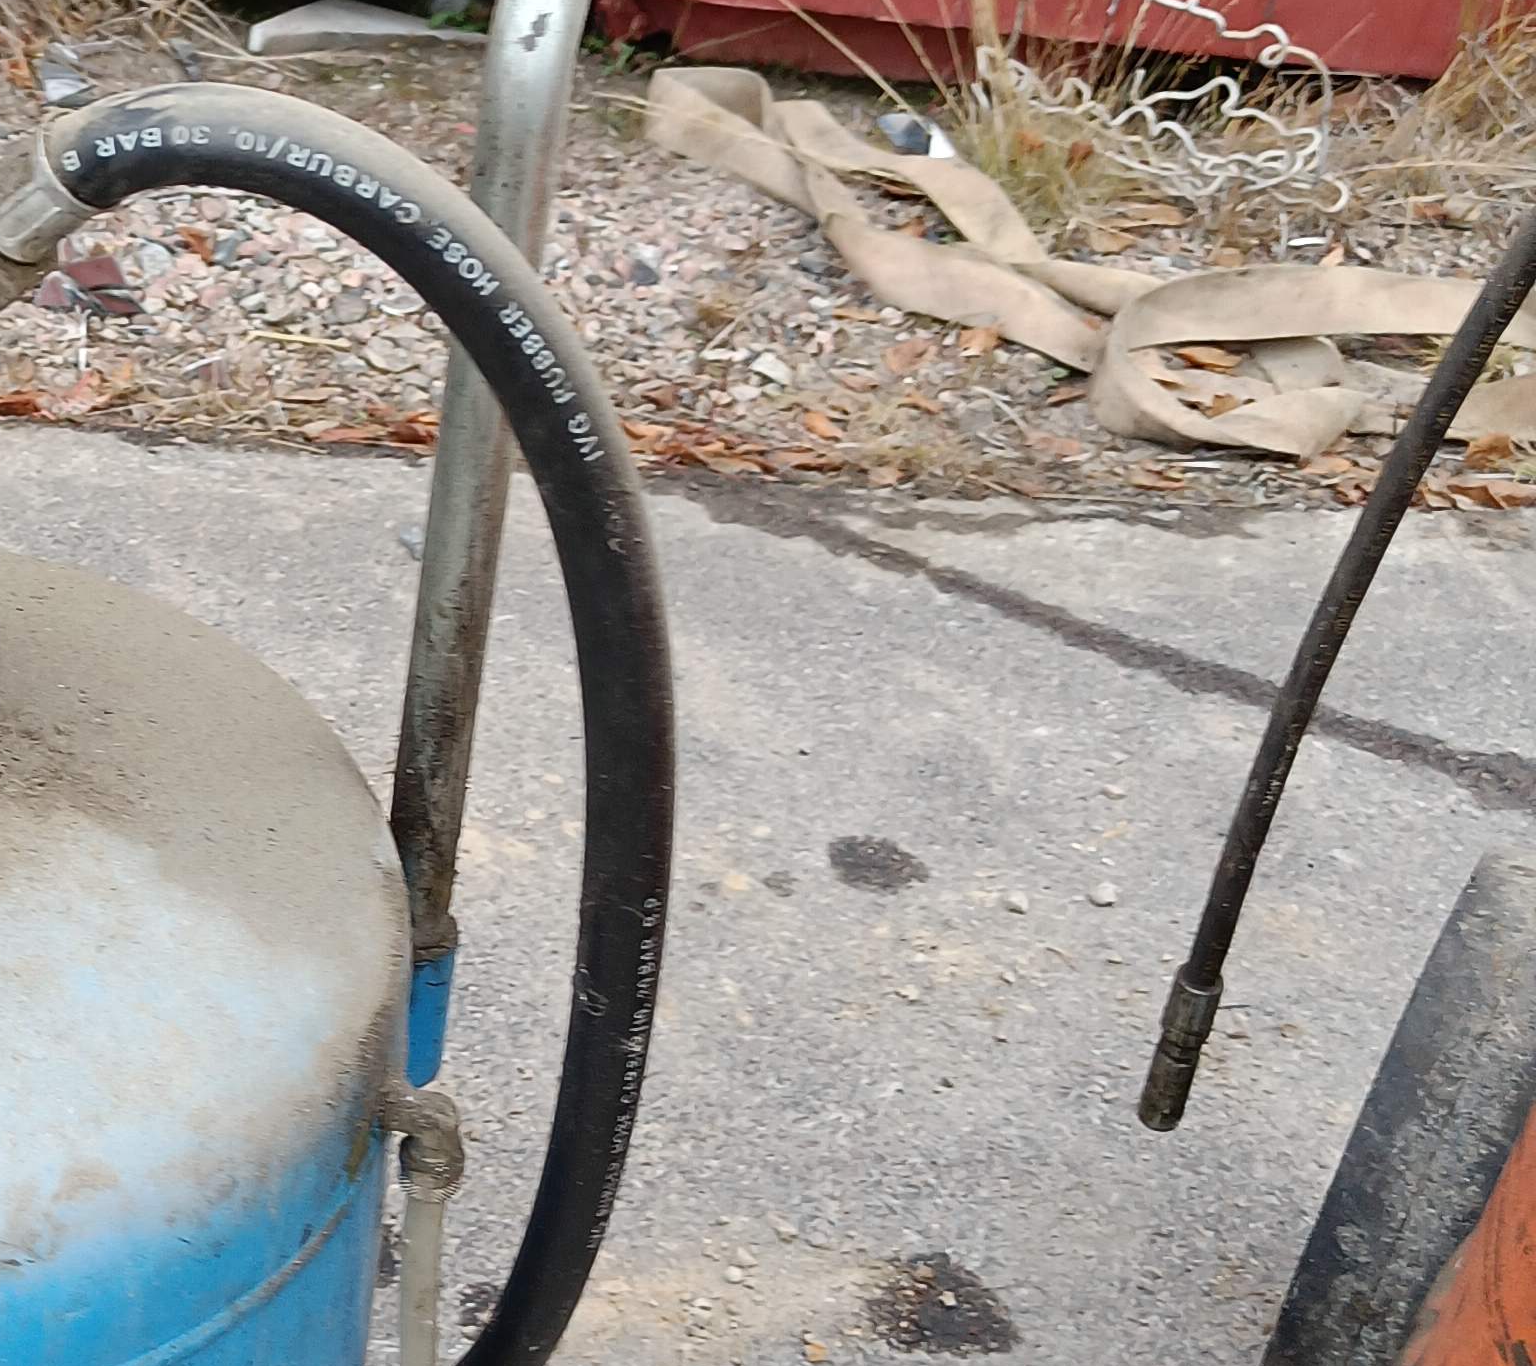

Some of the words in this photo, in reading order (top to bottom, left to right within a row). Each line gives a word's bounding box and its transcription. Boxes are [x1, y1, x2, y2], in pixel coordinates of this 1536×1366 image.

[94, 127, 162, 157] BAR
[171, 125, 210, 145] 30
[498, 301, 577, 404] RUBBER
